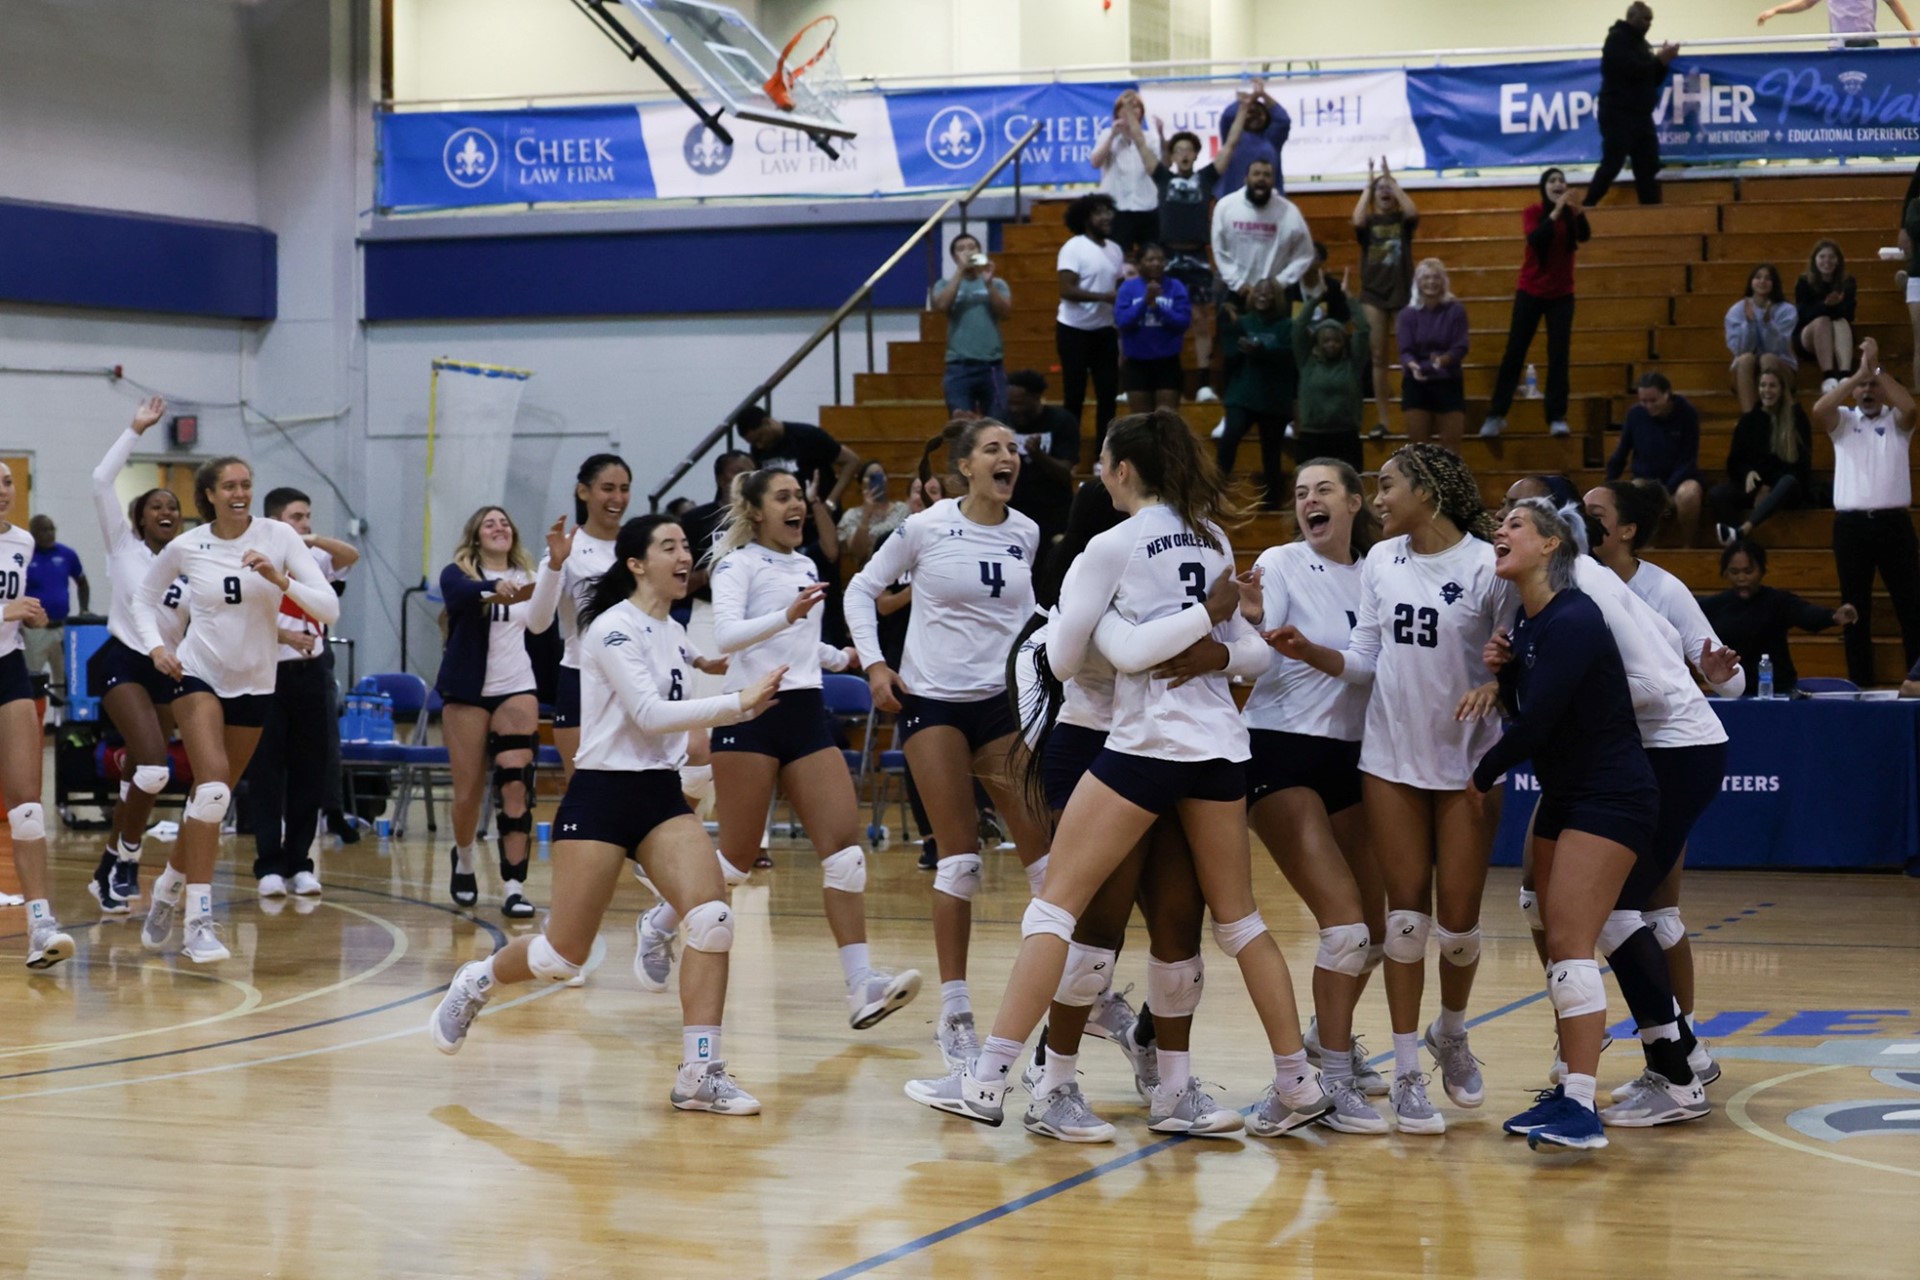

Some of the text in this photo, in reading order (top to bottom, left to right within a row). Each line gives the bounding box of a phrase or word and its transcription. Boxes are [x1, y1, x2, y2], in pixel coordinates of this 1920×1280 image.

[755, 126, 858, 155] CHEK
[1707, 130, 1771, 144] MENTORSHIP
[1787, 127, 1854, 143] EDUCATIONAL
[1856, 127, 1919, 142] EXPERIENCES
[515, 136, 615, 166] CHEEK
[520, 165, 615, 185] LAW FIRM
[761, 158, 800, 175] LAW
[1146, 532, 1225, 559] NEW ORLEA
[223, 575, 242, 605] 9
[979, 560, 1006, 599] 4
[1178, 561, 1207, 611] 3
[1393, 602, 1439, 649] 23
[667, 668, 684, 702] 6
[1514, 773, 1781, 793] NE TEERS
